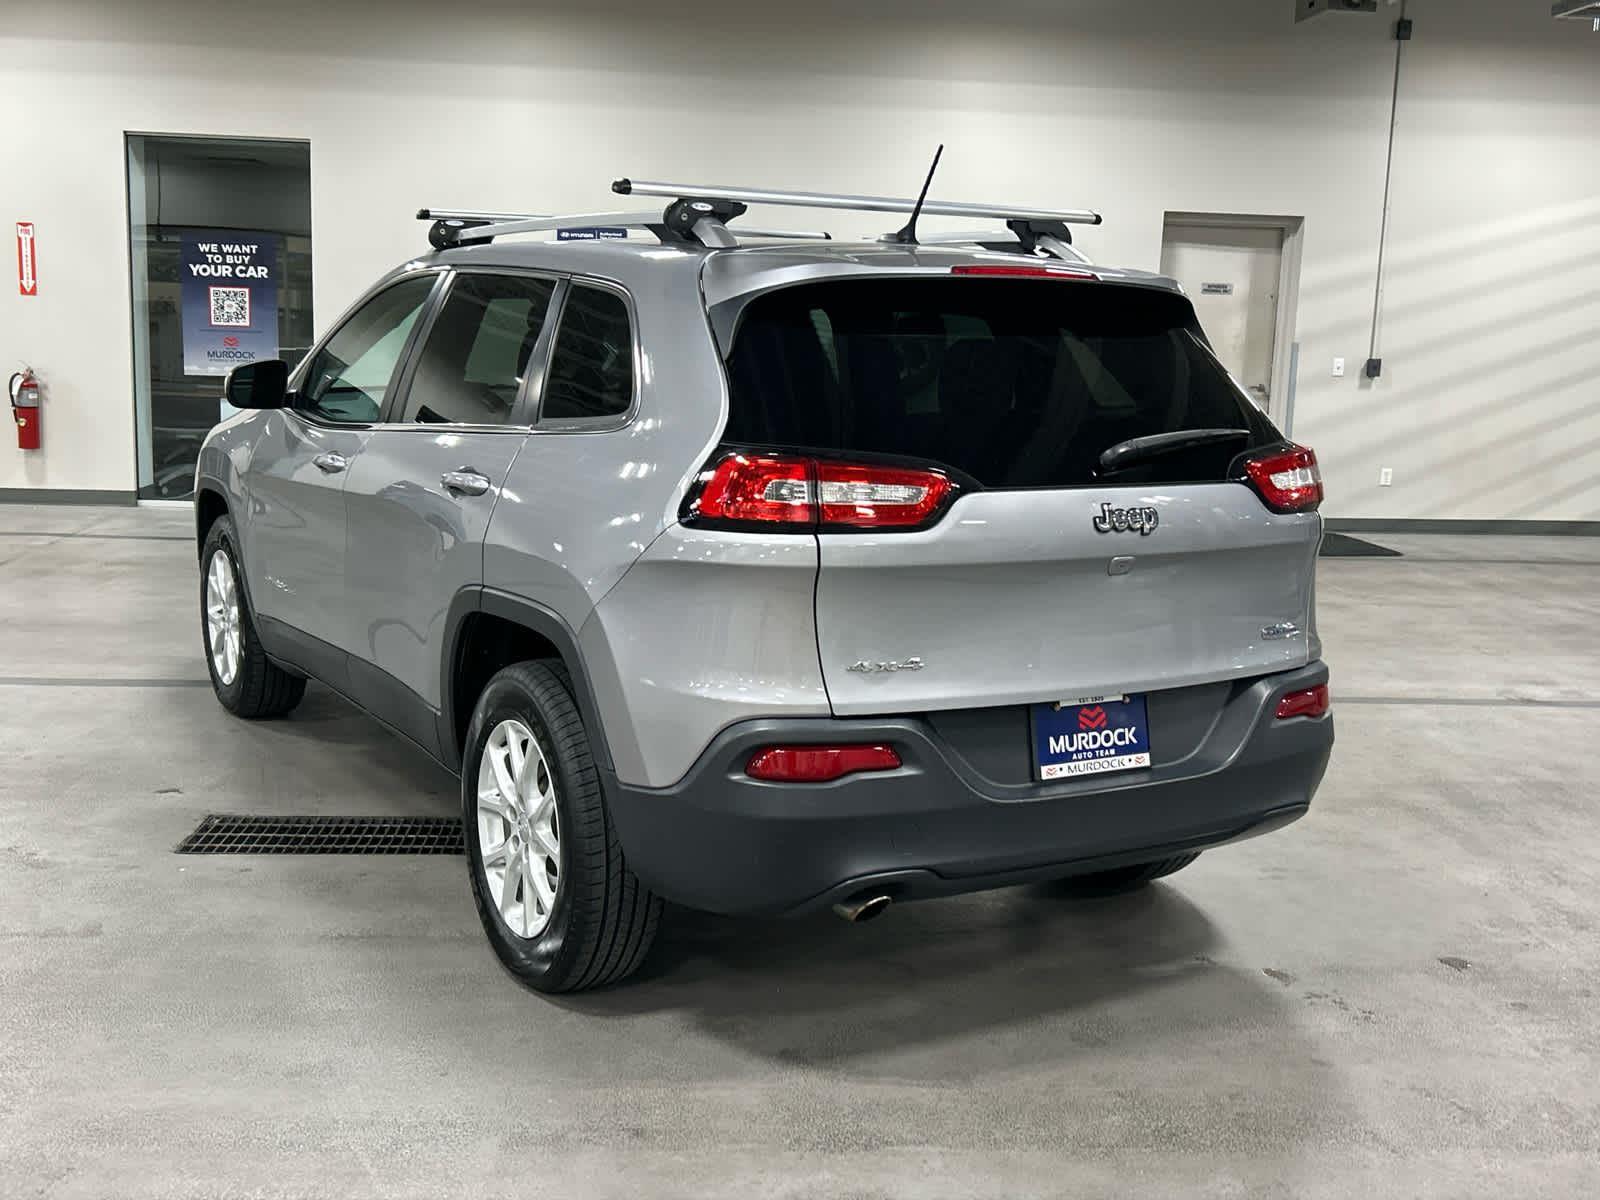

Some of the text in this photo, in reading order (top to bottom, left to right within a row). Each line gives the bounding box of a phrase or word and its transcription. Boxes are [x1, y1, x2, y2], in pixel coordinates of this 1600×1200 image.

[198, 243, 258, 254] WE WANT
[206, 254, 250, 265] TO BUY
[189, 264, 269, 279] YOUR CAR
[207, 350, 256, 360] MURDOCK
[1093, 502, 1159, 536] Jeep
[1048, 726, 1138, 755] MURDOCK
[1072, 748, 1116, 761] AUTO TEAM
[1067, 757, 1127, 775] MURDOCK
